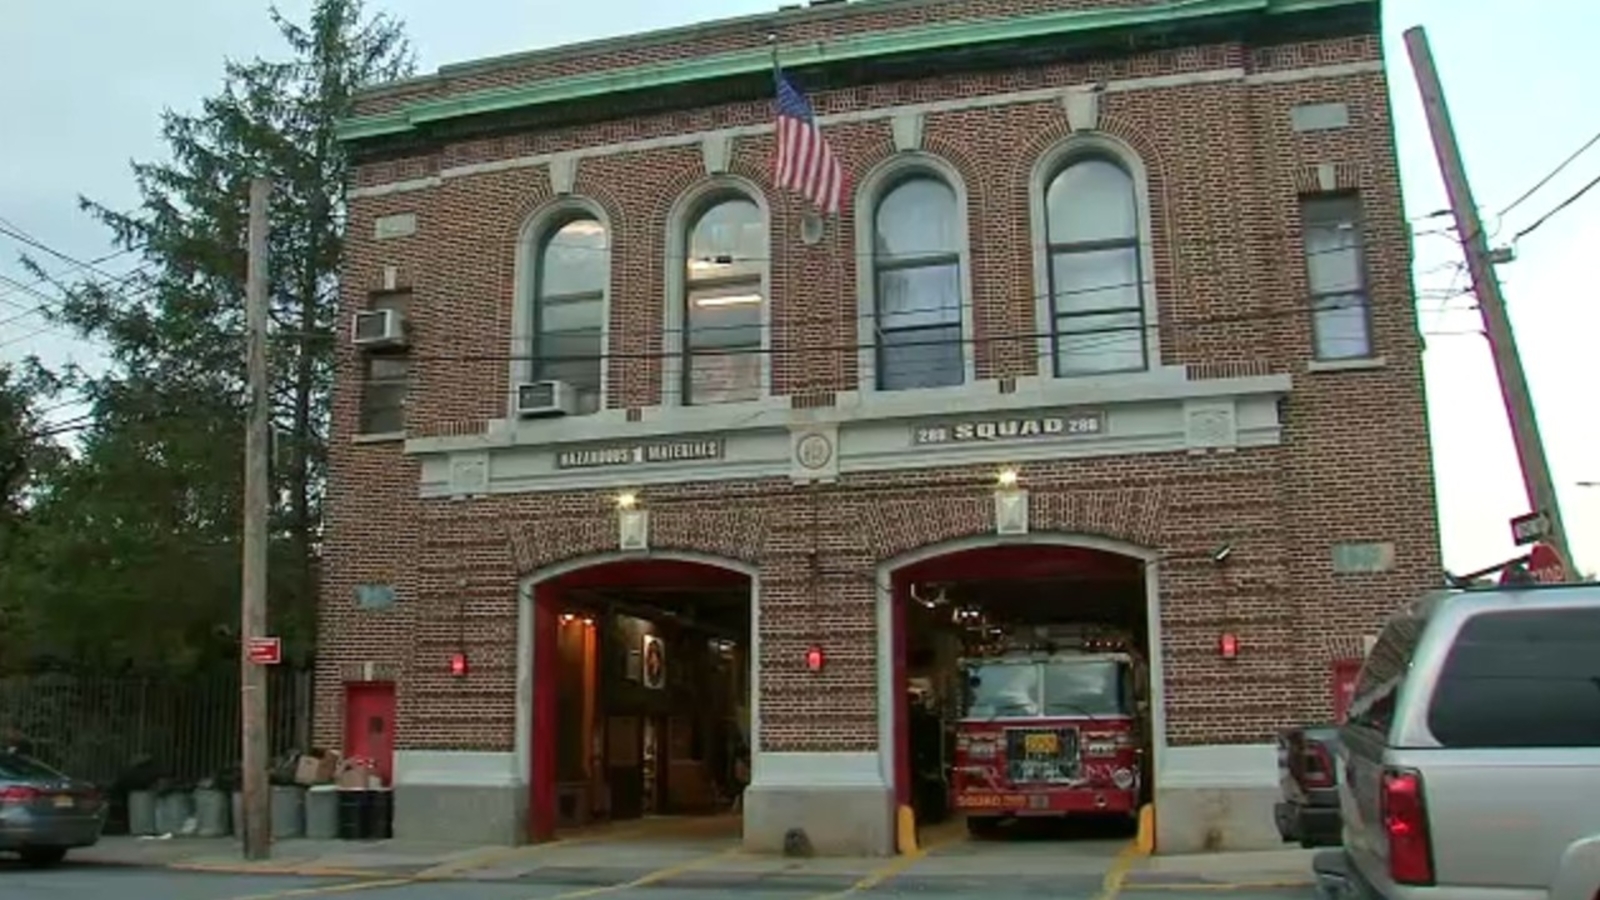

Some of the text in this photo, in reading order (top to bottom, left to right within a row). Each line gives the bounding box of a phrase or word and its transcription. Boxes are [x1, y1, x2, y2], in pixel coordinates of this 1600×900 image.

[953, 417, 1064, 440] SQUAD
[560, 448, 629, 467] HAZARDOUS
[647, 441, 718, 462] MATERIALS
